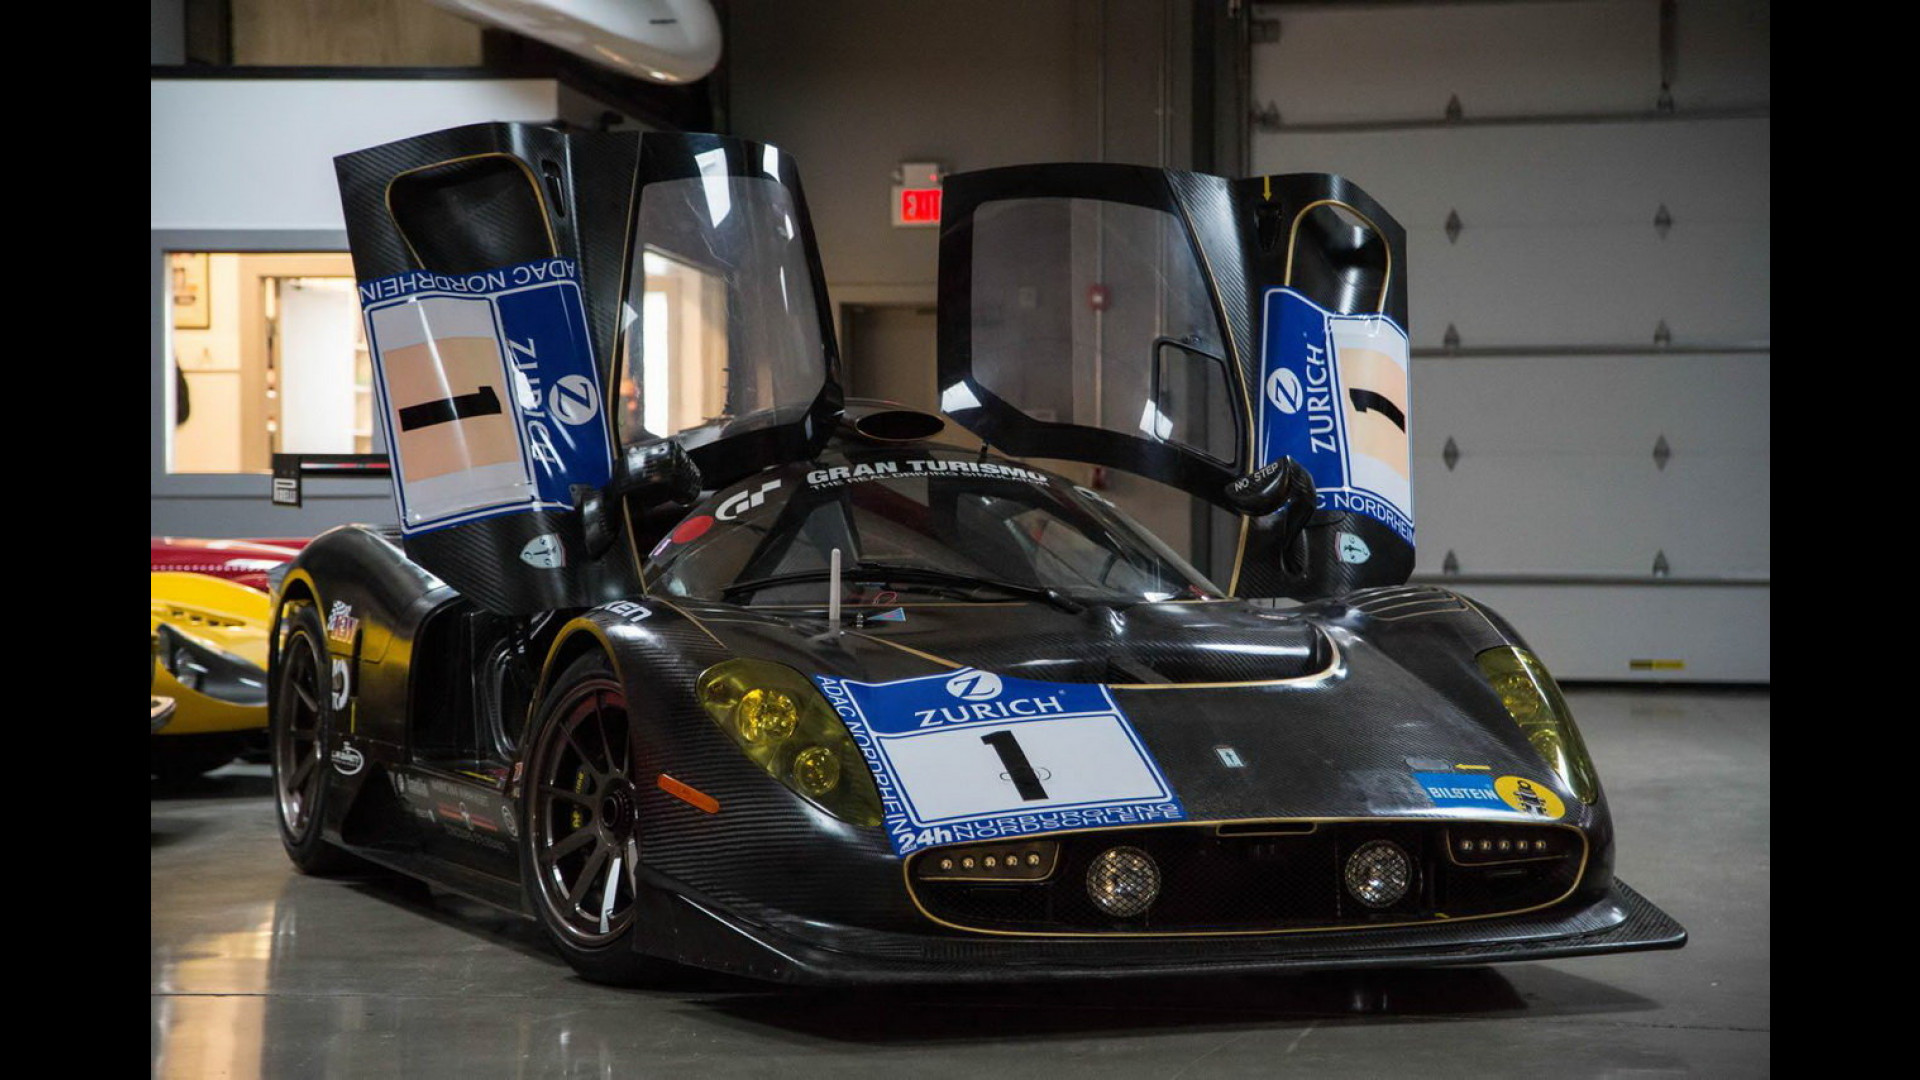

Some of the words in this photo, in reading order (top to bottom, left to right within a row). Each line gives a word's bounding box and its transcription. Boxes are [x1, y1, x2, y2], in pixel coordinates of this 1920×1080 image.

[359, 270, 505, 302] NORDRHEIN
[512, 259, 576, 284] ADAC
[399, 386, 502, 432] 1
[1306, 343, 1337, 455] ZURICH
[1348, 387, 1406, 435] 1
[806, 461, 898, 485] GRAN
[1233, 478, 1250, 493] NO
[1253, 462, 1280, 483] STEP
[1334, 492, 1416, 545] NORDRHEIN
[914, 696, 1064, 728] ZURICH
[817, 674, 857, 718] ADAC
[846, 720, 909, 837] NORDRHEIN
[980, 729, 1050, 802] 1
[1427, 786, 1499, 801] BILSTEIN
[898, 827, 953, 855] 24h
[955, 811, 1182, 842] NORDSCHLEIFE
